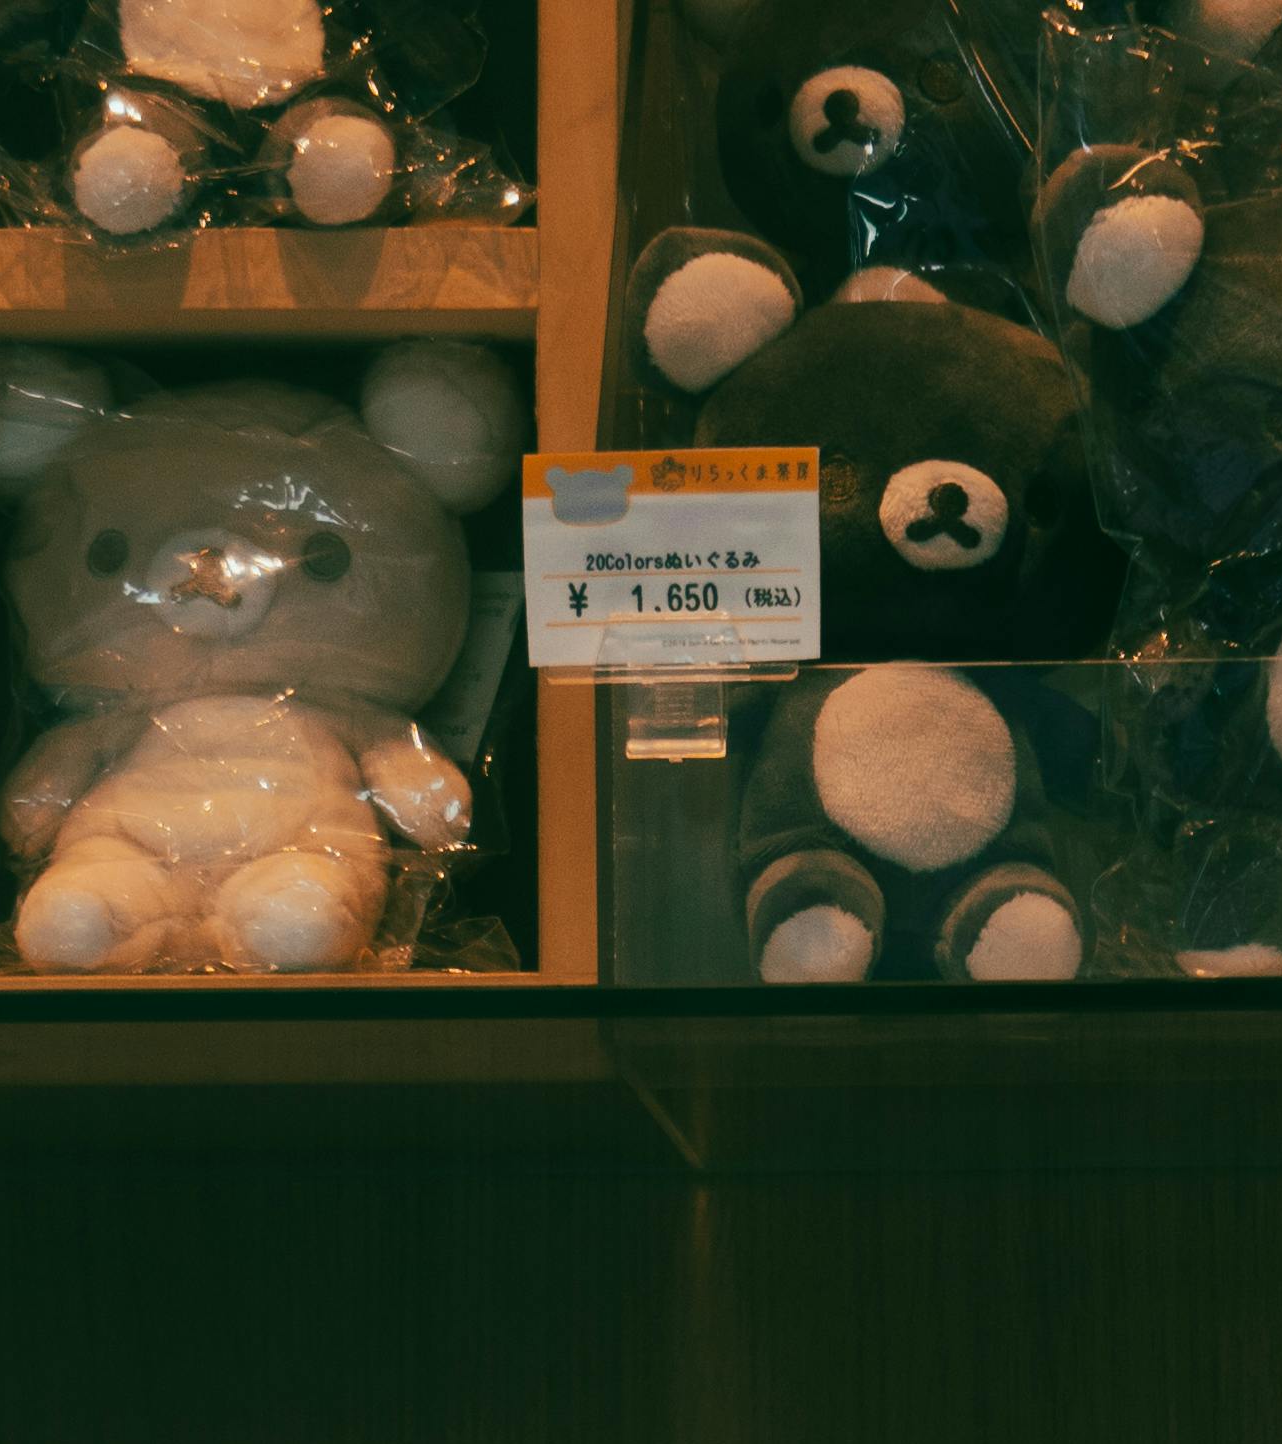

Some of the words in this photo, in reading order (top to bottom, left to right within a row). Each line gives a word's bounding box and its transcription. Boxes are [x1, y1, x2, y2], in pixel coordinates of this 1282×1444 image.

[586, 552, 760, 571] 20Colorsぬいぐるみ
